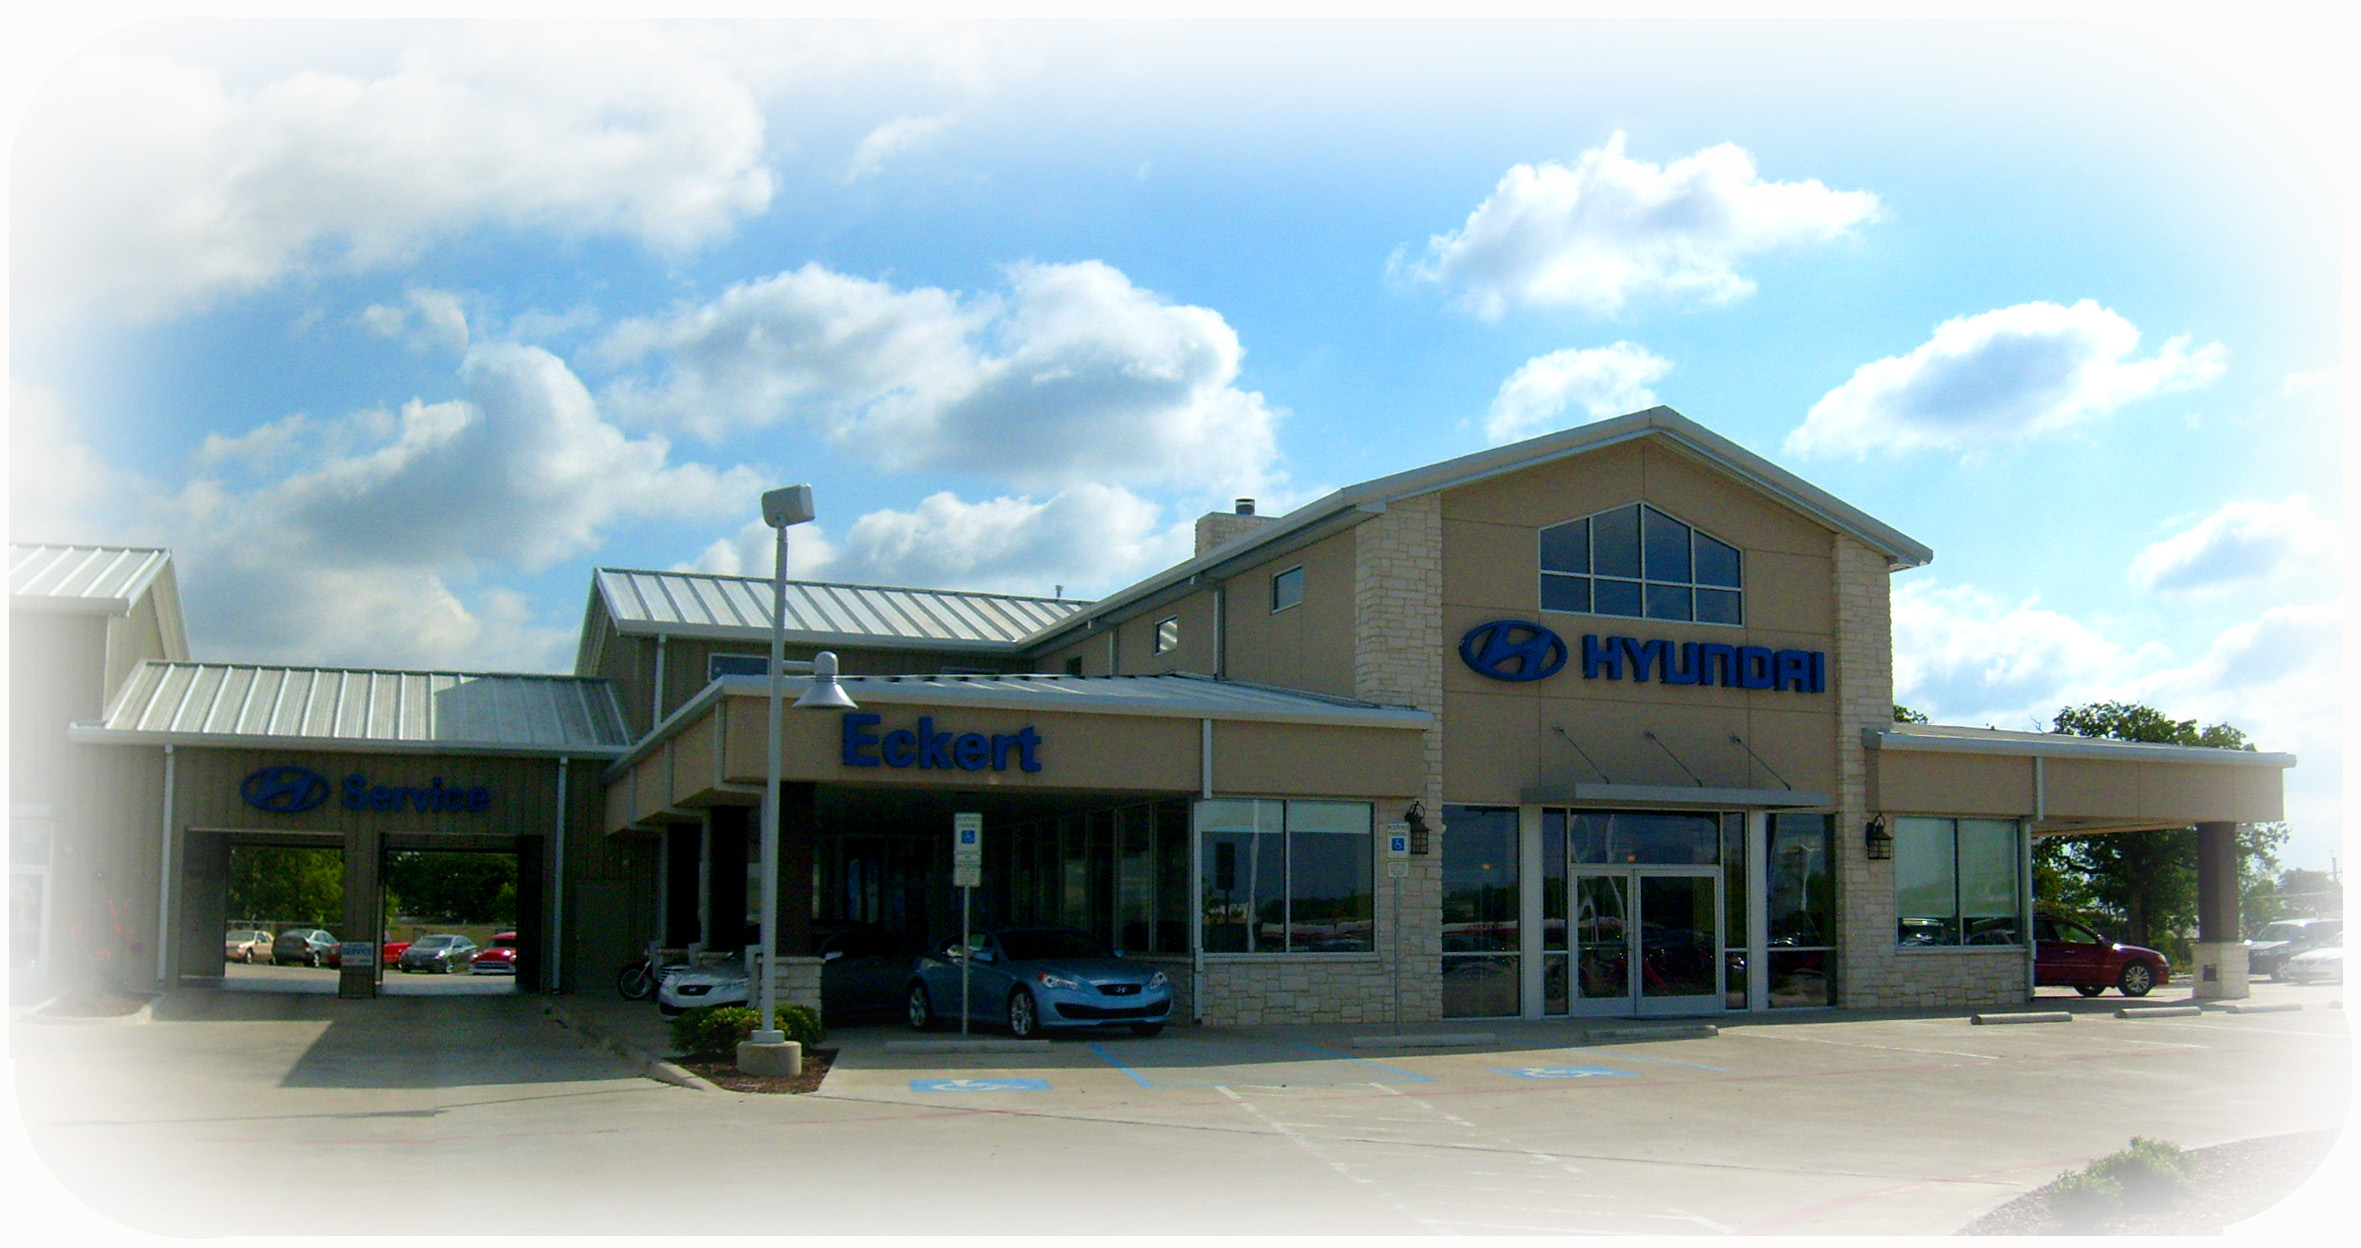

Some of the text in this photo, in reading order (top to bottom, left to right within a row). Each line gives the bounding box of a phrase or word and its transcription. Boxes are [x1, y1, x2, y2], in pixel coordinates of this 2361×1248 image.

[1582, 634, 1825, 693] HYUNDAI
[842, 713, 1042, 773] Eckert
[341, 774, 491, 812] Service
